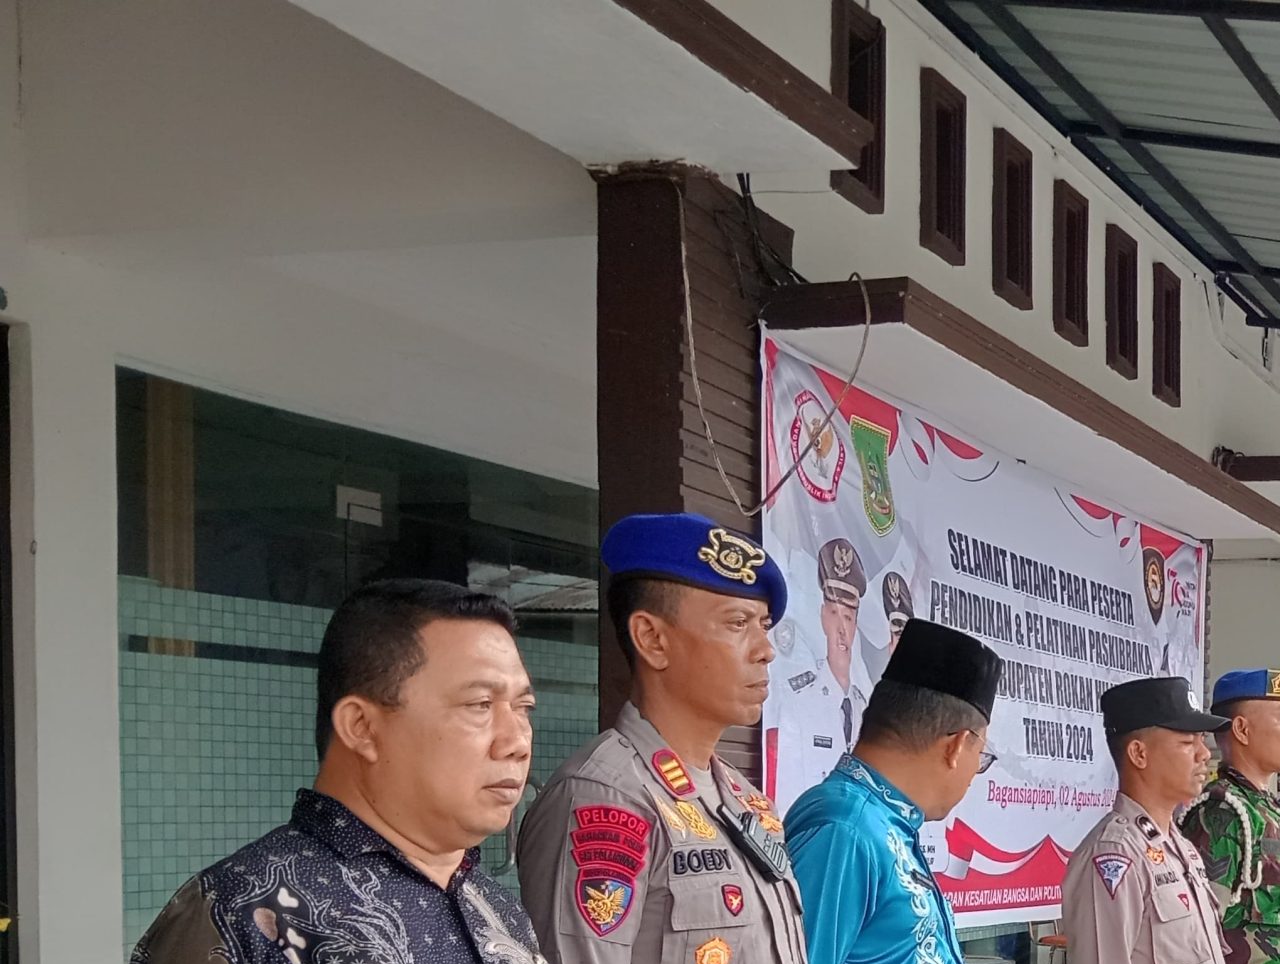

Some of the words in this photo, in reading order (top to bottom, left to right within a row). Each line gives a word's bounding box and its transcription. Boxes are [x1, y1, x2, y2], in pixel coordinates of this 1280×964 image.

[947, 528, 1009, 587] SELAMAT
[1009, 552, 1057, 603] DATANG
[1058, 569, 1089, 612] PARA
[1089, 580, 1135, 626] PESERTA
[929, 580, 1014, 643] PENDIDIKAN
[1014, 612, 1025, 647] &
[1025, 610, 1088, 662] PELATIHAN
[1088, 628, 1154, 677] PASKIBRAKA
[996, 658, 1053, 705] BUPATEN
[1055, 670, 1094, 712] ROKAN
[1023, 717, 1065, 759] TAHUN
[1065, 723, 1094, 762] 2024
[987, 780, 1057, 810] Bagansiapiapi,
[1058, 785, 1070, 806] 02
[1071, 789, 1102, 811] Agustus
[582, 809, 646, 836] PELOPOR
[673, 848, 732, 876] BOEDY
[964, 888, 1001, 907] KESATUAN
[1002, 887, 1029, 904] BANGSA
[1029, 886, 1042, 902] DAN
[1043, 885, 1062, 900] POLITI
